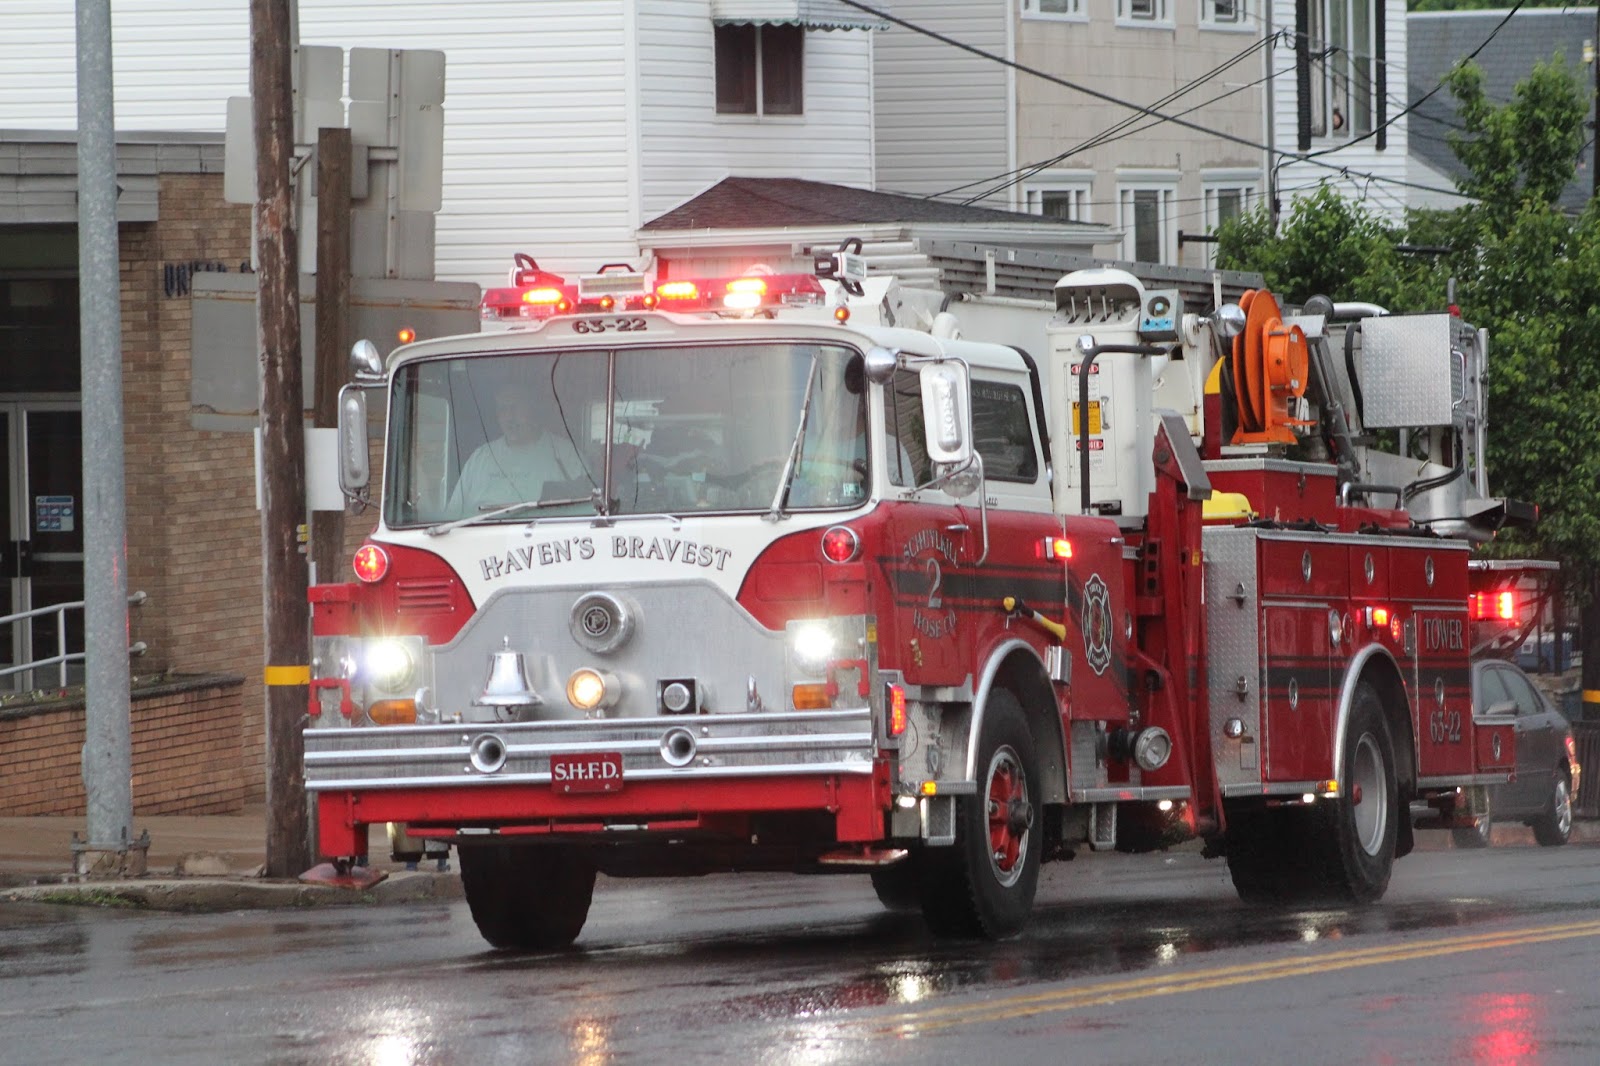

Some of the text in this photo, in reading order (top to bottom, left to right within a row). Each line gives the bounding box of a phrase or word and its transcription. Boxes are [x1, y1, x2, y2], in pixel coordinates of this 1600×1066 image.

[572, 317, 648, 334] 63-22
[478, 535, 732, 581] HAVEN'S BRAVEST
[926, 557, 942, 609] 2
[913, 607, 942, 638] HOSE
[1424, 617, 1464, 651] TOWER
[1430, 710, 1461, 742] 63-22
[554, 761, 620, 781] S.H.F.D.
